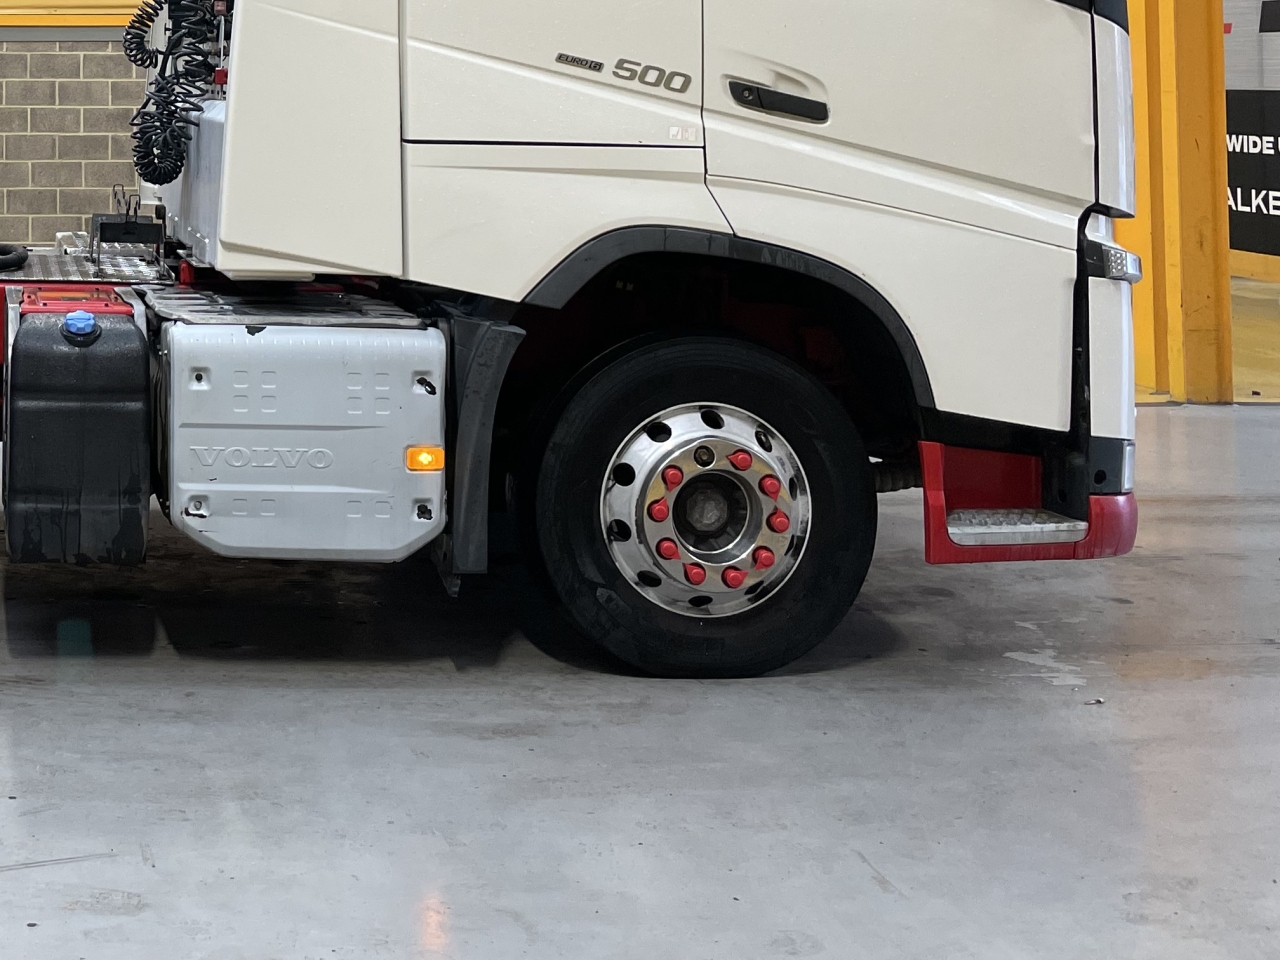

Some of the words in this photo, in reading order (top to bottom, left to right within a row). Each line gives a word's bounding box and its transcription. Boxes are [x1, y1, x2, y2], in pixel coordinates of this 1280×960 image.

[558, 53, 588, 67] EURO
[612, 58, 692, 94] 500
[1226, 134, 1275, 155] WIDE
[189, 445, 334, 470] VOLVO
